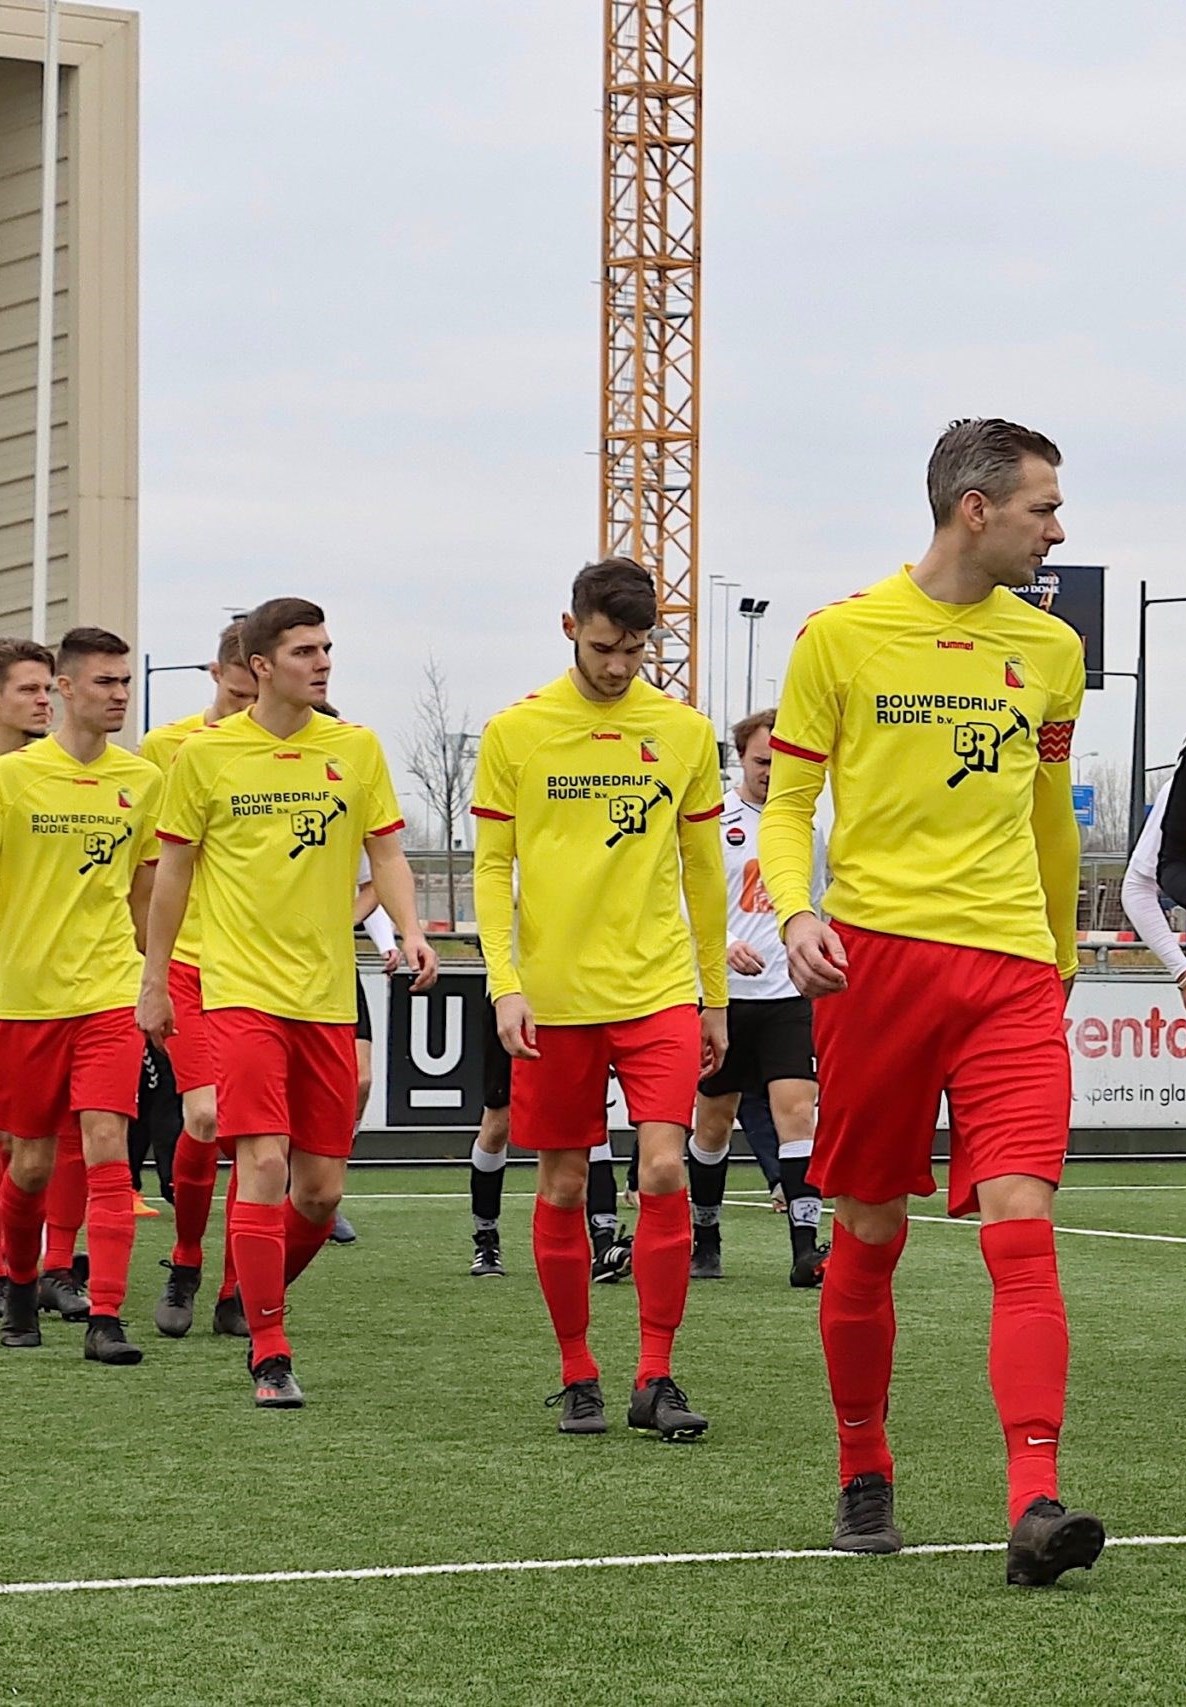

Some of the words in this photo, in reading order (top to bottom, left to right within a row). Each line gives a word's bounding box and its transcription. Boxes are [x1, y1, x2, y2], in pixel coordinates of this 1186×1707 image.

[936, 640, 974, 650] hummel
[876, 695, 1007, 711] BOUWBEDRIJF
[876, 711, 932, 724] RUDIE
[936, 715, 955, 725] b.v.
[547, 775, 652, 787] BOUWBEDRIJF
[231, 791, 330, 805] BOUWBEDRIJF
[547, 788, 591, 799] RUDIE
[232, 804, 273, 817] RUDIE
[31, 814, 123, 825] BOUWBEDRIJF
[31, 824, 70, 834] RUDIE
[1072, 1085, 1134, 1106] perts
[1139, 1084, 1154, 1101] in
